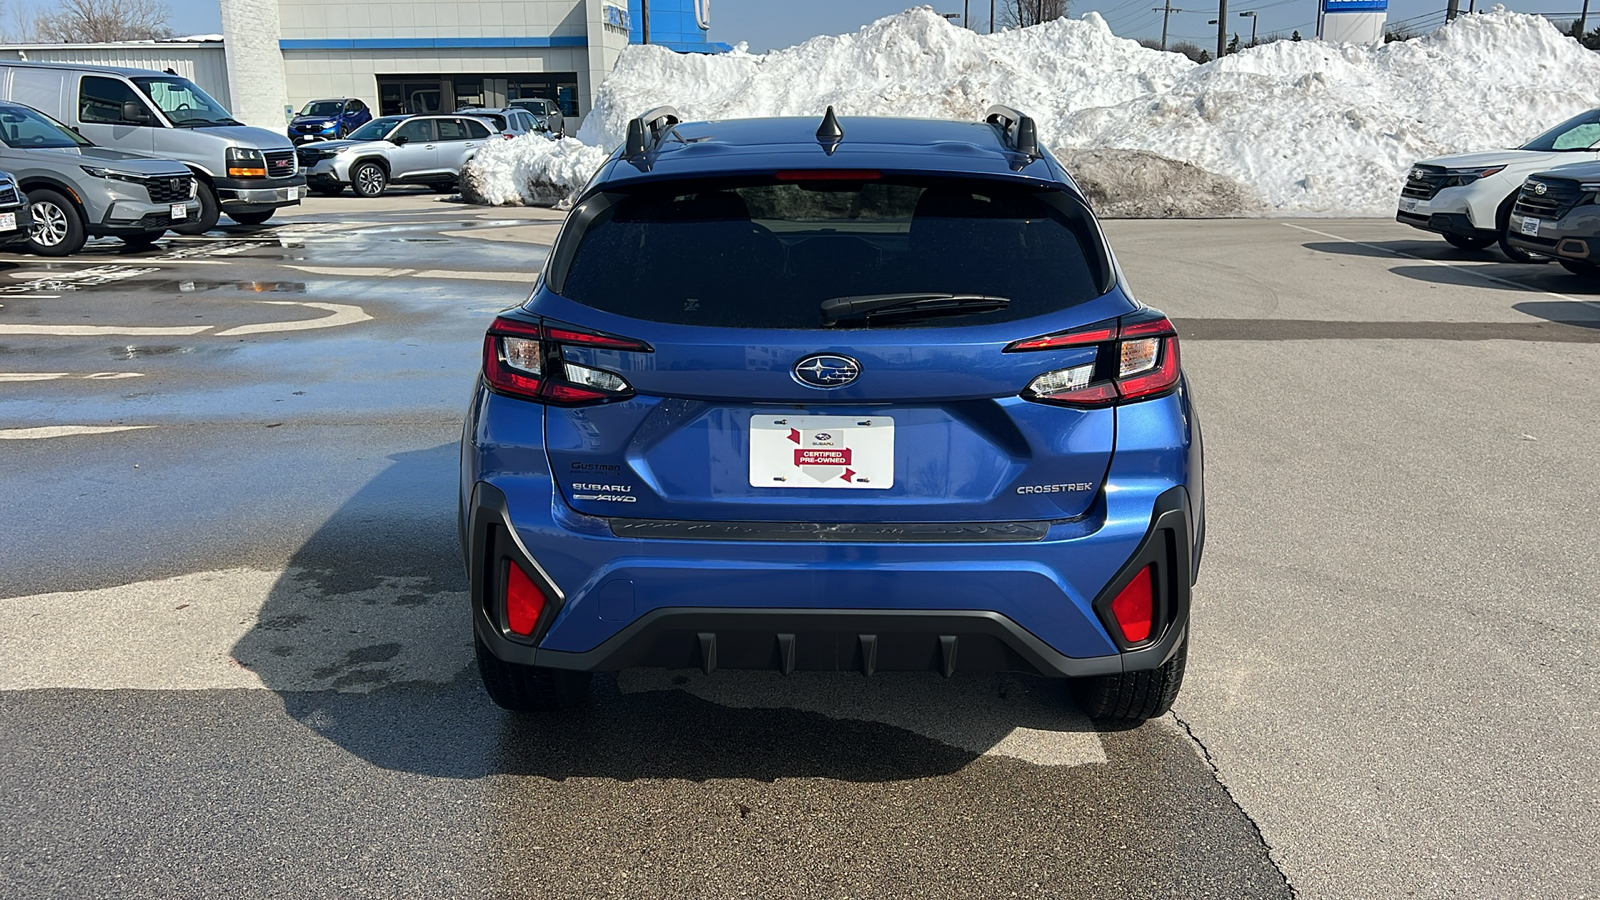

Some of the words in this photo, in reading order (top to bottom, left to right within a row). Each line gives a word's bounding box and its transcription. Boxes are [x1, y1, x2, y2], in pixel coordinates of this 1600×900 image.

[572, 482, 631, 492] SUBARU
[1016, 482, 1093, 494] CROSSTREK
[598, 494, 637, 503] AWD
